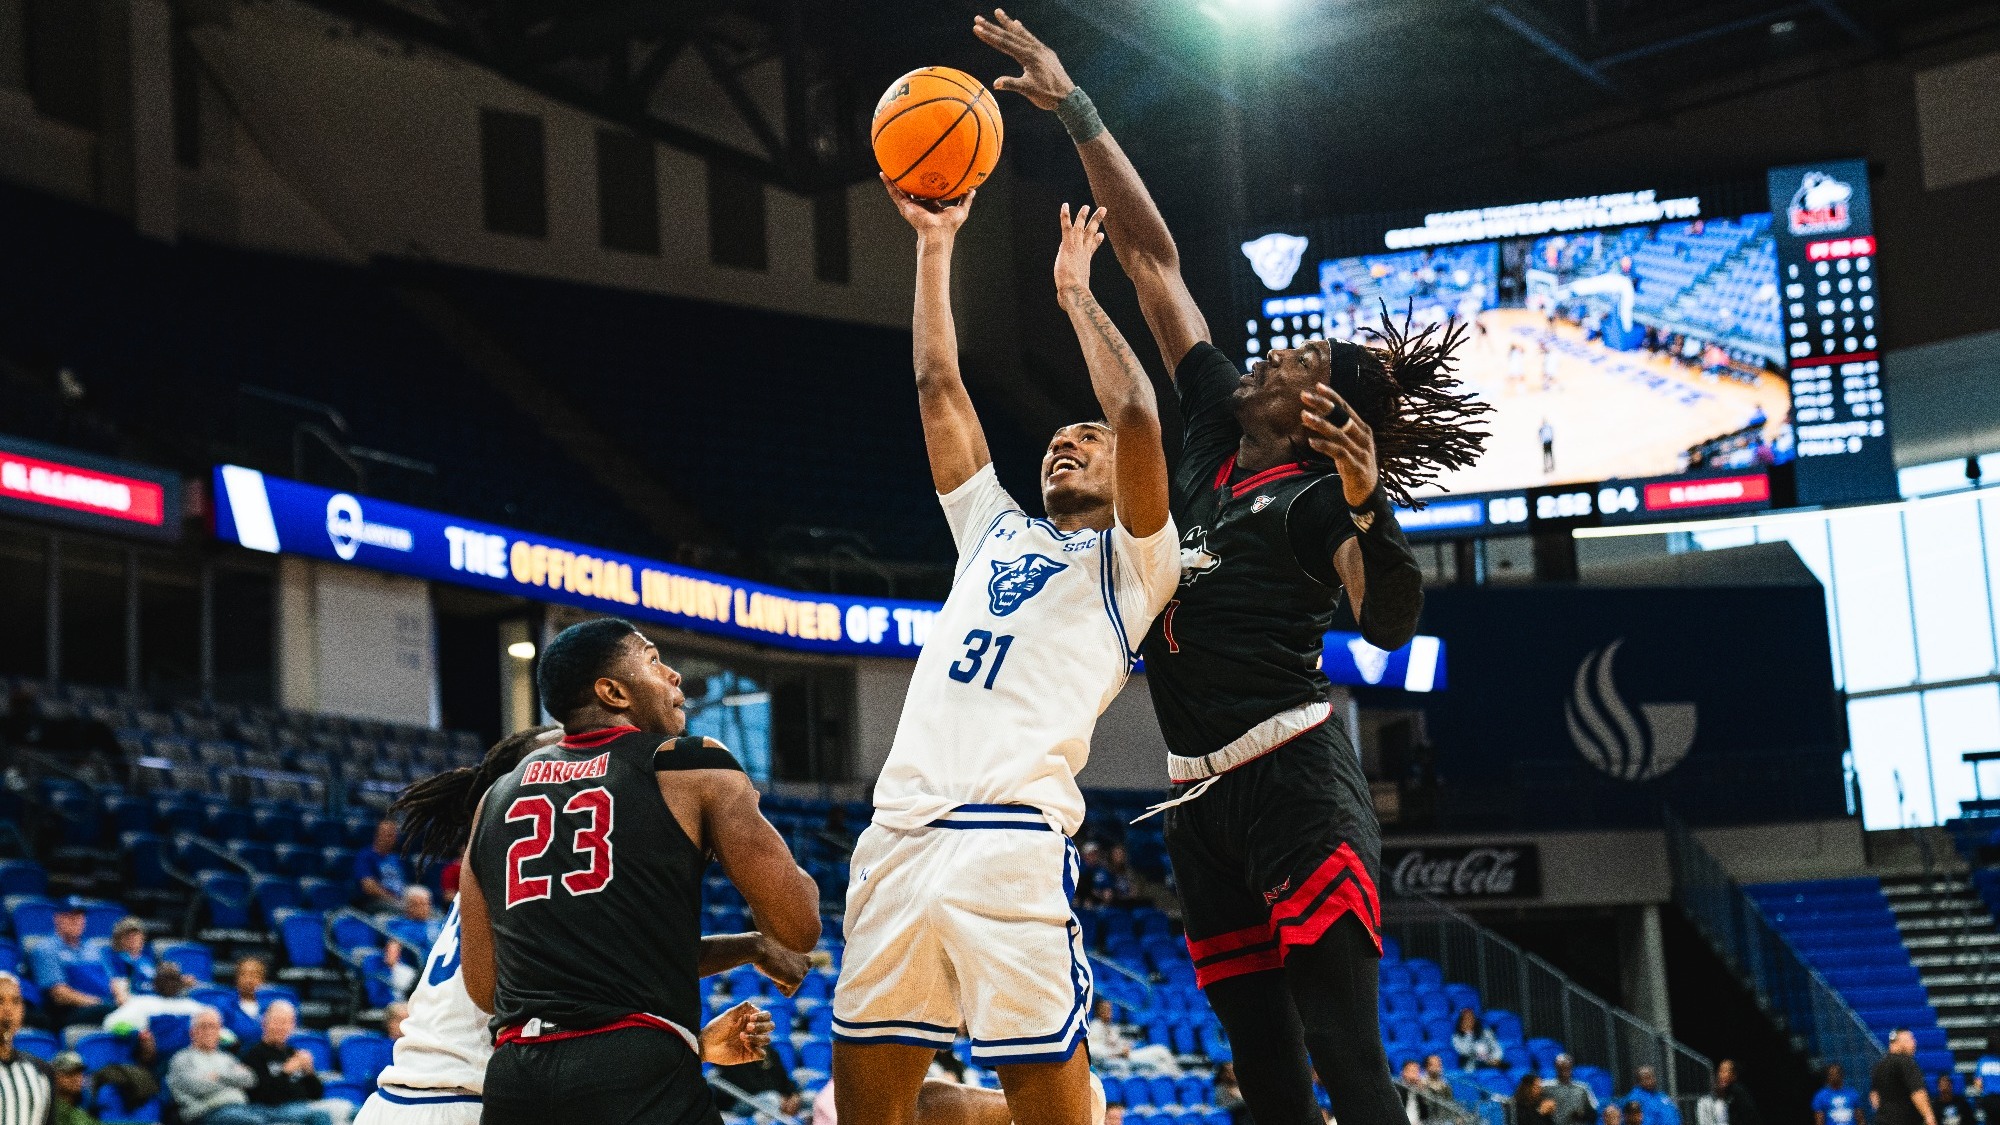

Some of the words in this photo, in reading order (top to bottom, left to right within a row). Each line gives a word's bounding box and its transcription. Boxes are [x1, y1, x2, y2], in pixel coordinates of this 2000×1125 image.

[444, 526, 508, 579] THE
[510, 540, 640, 606] OFFICIAL
[640, 568, 732, 623] INJURY
[734, 588, 841, 643] LAWYER
[846, 604, 890, 645] OF
[893, 607, 941, 647] TH
[948, 628, 1015, 690] 31
[520, 751, 611, 787] IBARGUEN
[505, 786, 614, 911] 23
